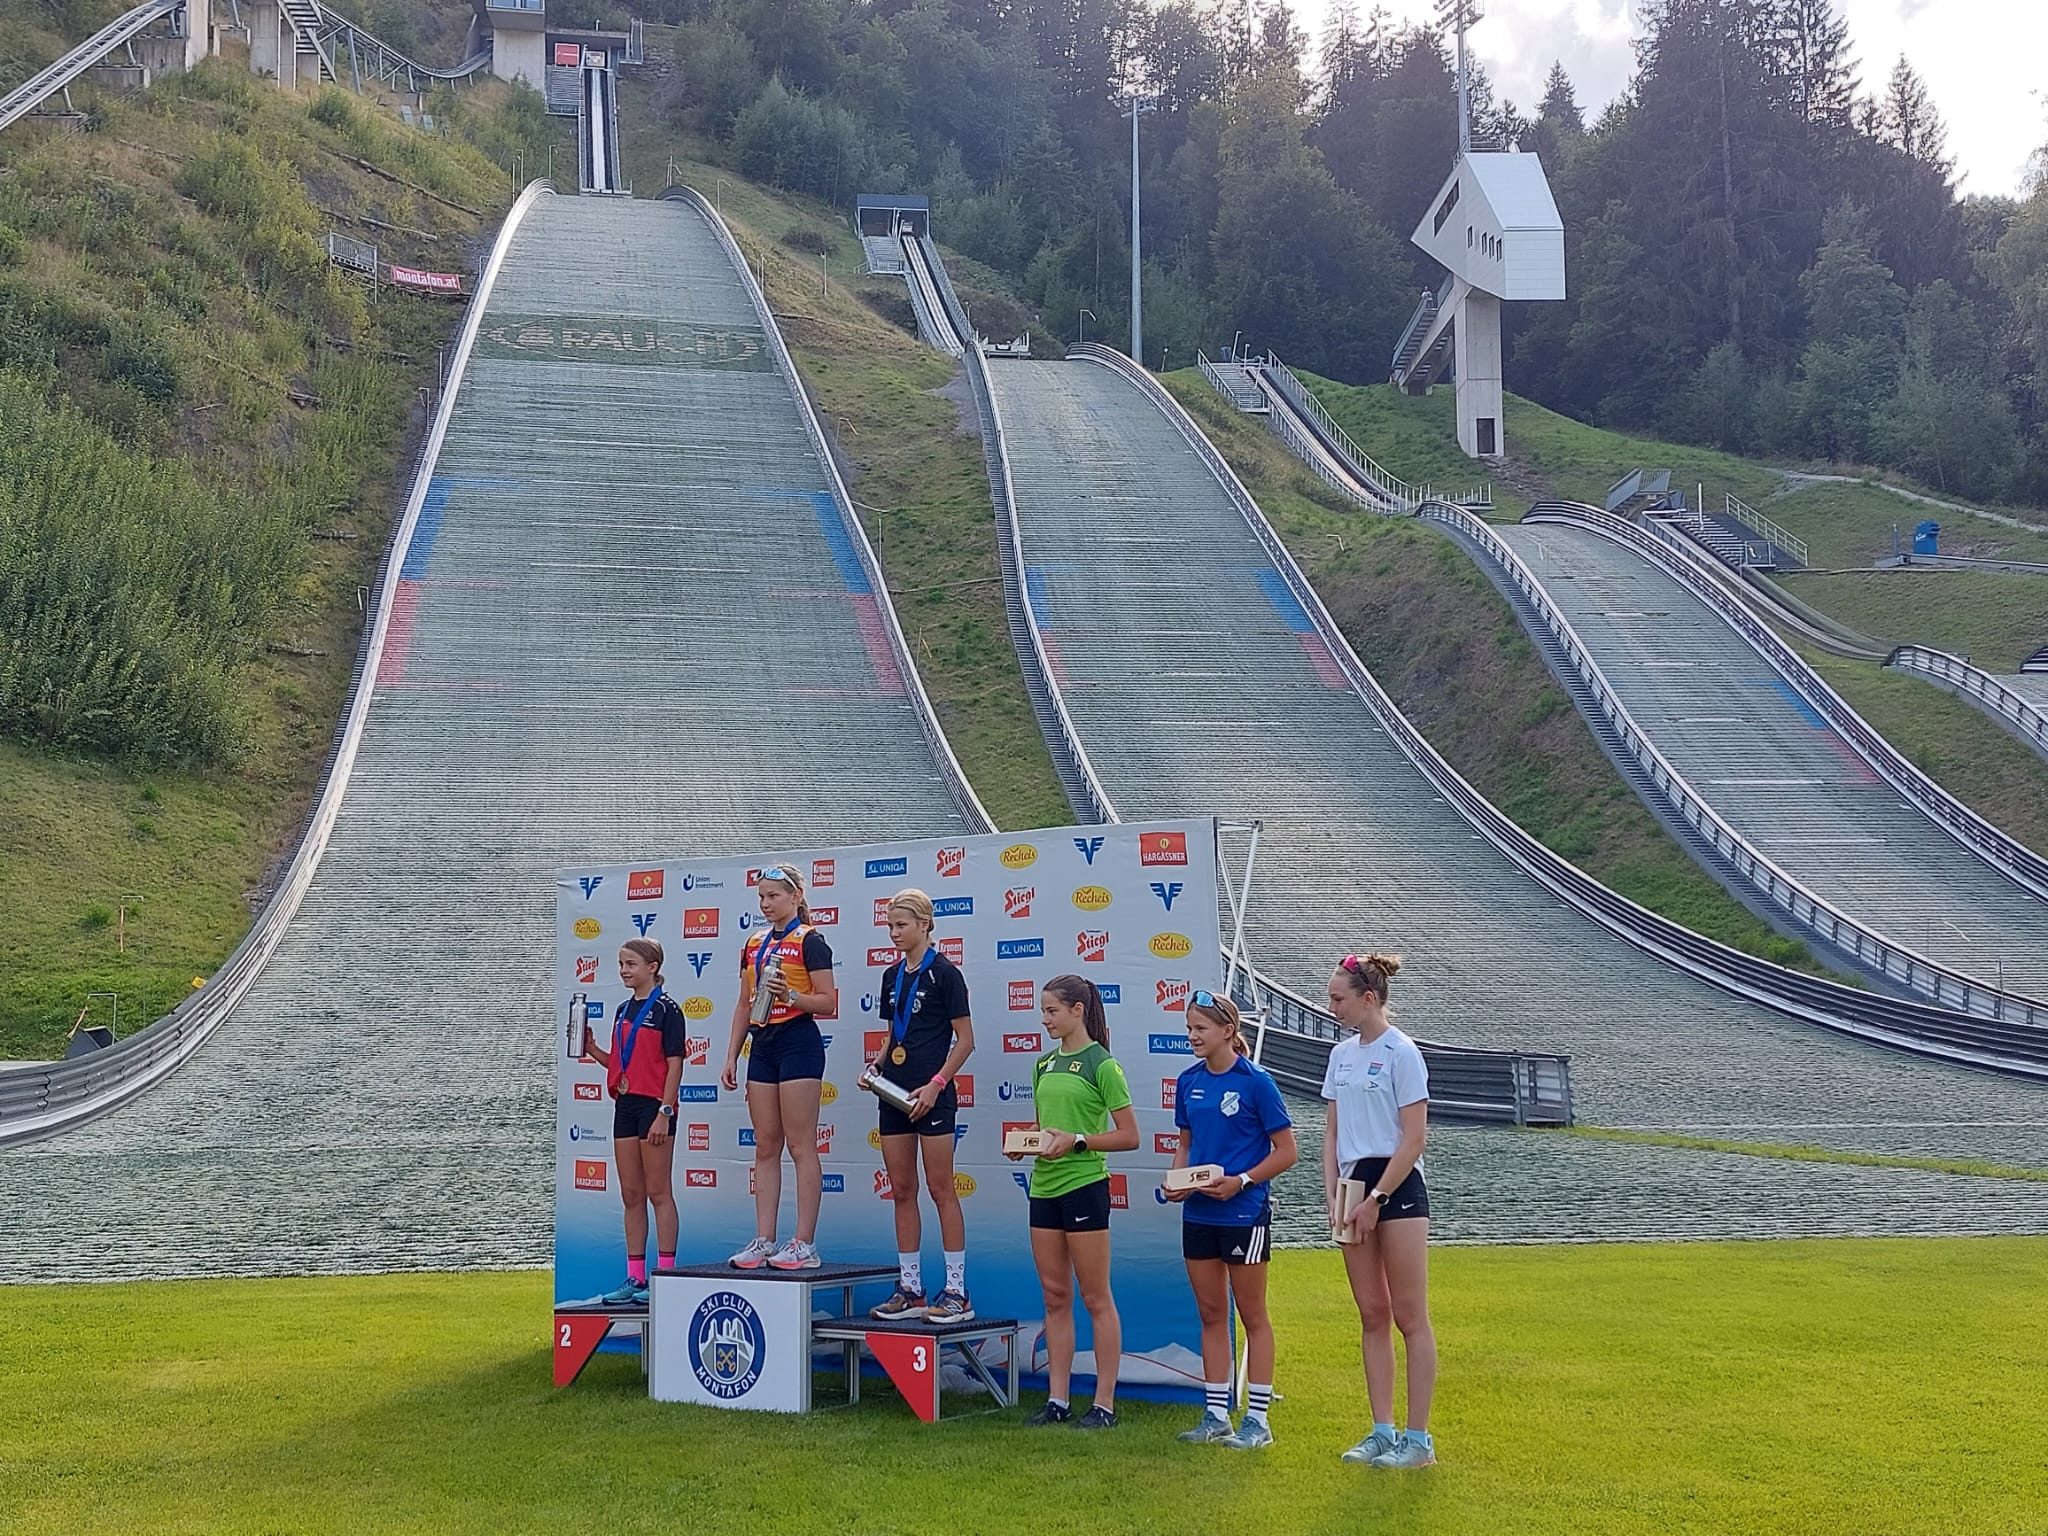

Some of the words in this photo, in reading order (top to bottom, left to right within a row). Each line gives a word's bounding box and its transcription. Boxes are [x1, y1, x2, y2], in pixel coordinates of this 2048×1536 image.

[396, 270, 458, 288] montafon.at
[936, 846, 966, 873] Stiegl
[1003, 849, 1036, 863] Recheis
[880, 863, 905, 873] UNIQA
[1005, 887, 1035, 914] Stiegl
[1076, 889, 1110, 904] Recheis
[944, 903, 971, 912] UNIQA
[1013, 943, 1042, 954] UNIQA
[1077, 931, 1109, 956] Stiegl
[1153, 935, 1190, 951] Recheis
[576, 956, 599, 977] Stiegl
[1009, 986, 1033, 996] Kronen
[1101, 990, 1118, 999] IQA
[1156, 980, 1190, 1005] Stiegl
[1167, 1039, 1192, 1049] UNIQ
[692, 1089, 716, 1098] UNIQA
[1163, 1082, 1176, 1092] Kro
[822, 1178, 842, 1189] NIQA
[700, 1297, 719, 1317] SKI
[722, 1294, 753, 1318] CLUB
[560, 1324, 571, 1347] 2
[912, 1345, 927, 1372] 3
[695, 1365, 757, 1398] MONTAFON
